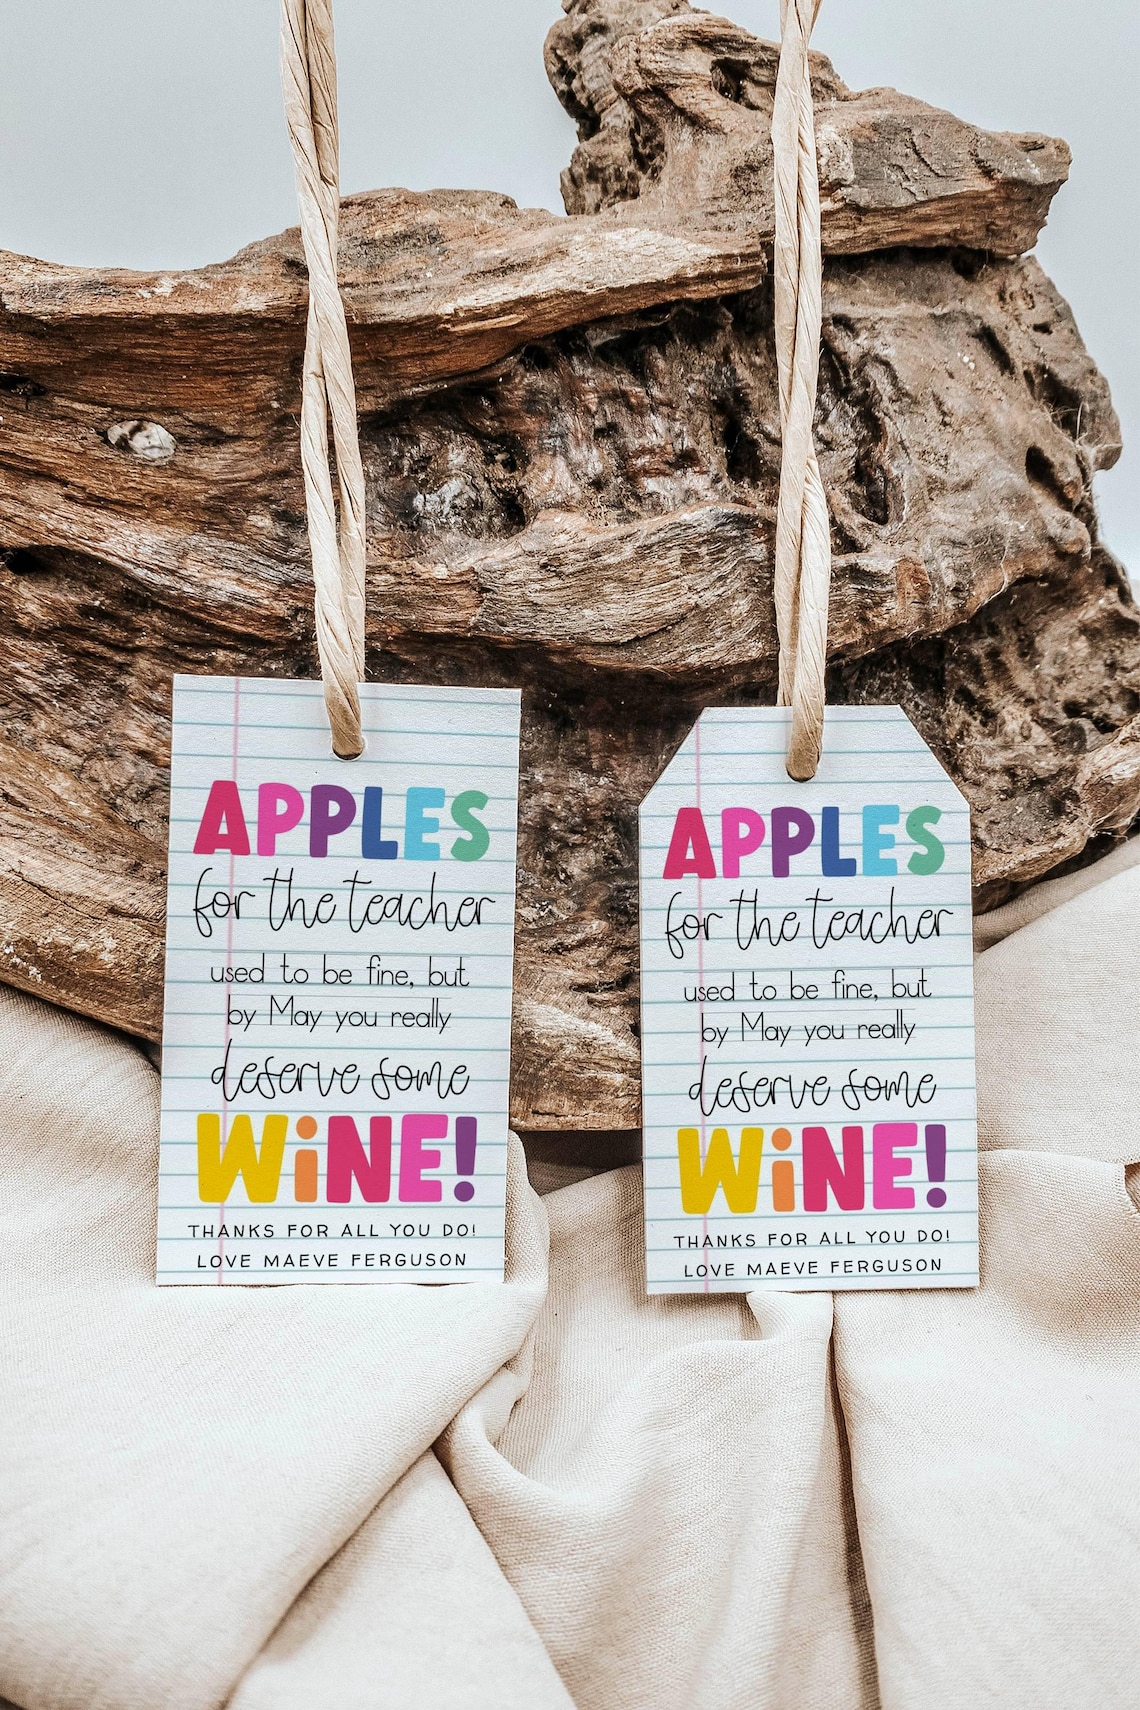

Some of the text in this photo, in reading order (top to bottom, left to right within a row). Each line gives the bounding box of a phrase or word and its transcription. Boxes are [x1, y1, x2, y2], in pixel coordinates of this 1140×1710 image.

[192, 779, 490, 862] APPLES
[662, 804, 944, 880] APPLES
[192, 867, 496, 938] for the teacher
[664, 886, 954, 960] for the teacher
[210, 952, 470, 989] used to be fine, but
[684, 967, 932, 1003] used to be fine, but
[227, 993, 452, 1035] by May you really
[701, 1008, 916, 1049] by May you really
[210, 1038, 470, 1102] deserve some
[688, 1055, 937, 1117] deserve some
[187, 1223, 475, 1238] THANKS FOR ALL YOU DO!
[673, 1229, 950, 1249] THANKS FOR ALL YOU DO!
[197, 1253, 466, 1268] LOVE MAEVE FERGUSON
[684, 1258, 941, 1278] LOVE MAEVE FERGUSON
